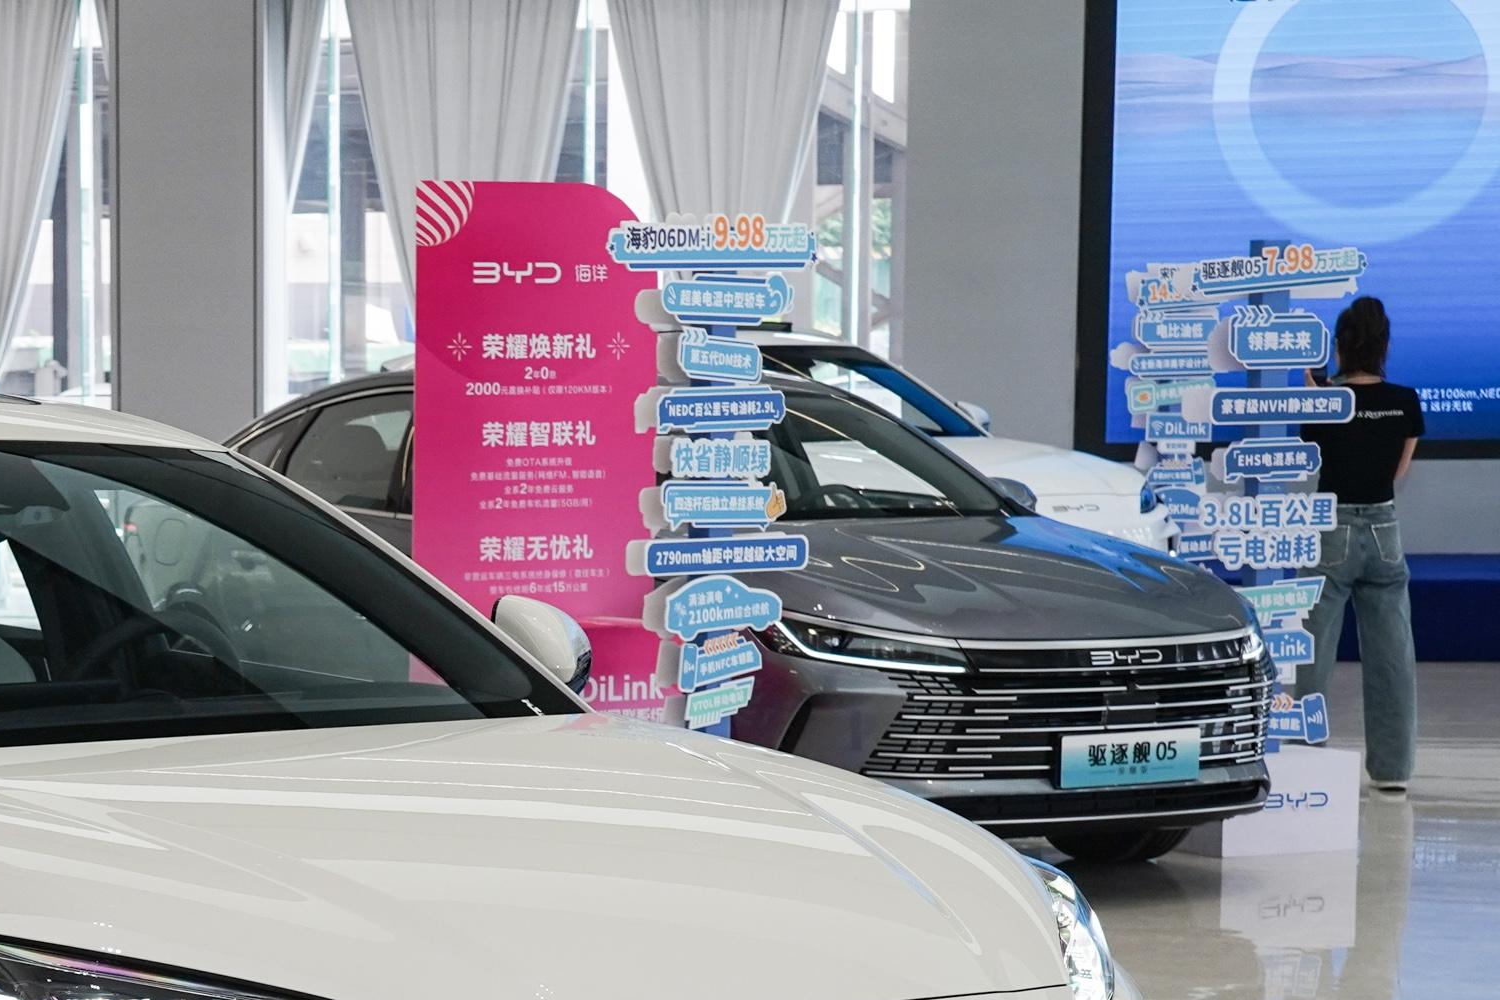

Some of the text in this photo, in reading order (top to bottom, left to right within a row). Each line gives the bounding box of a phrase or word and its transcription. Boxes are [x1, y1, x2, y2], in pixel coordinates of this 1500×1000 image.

[473, 262, 609, 284] BYD 海洋
[1202, 259, 1262, 280] 驱逐舰05
[482, 333, 597, 360] 荣耀焕新礼
[482, 420, 597, 447] 荣耀智联礼
[1164, 422, 1207, 437] DiLink
[1203, 498, 1334, 528] 3.8L百公里
[479, 534, 594, 563] 荣耀无忧礼
[1219, 535, 1318, 565] 亏电油耗
[1090, 649, 1163, 666] BYD
[1268, 637, 1308, 657] Link
[1088, 741, 1178, 766] 驱逐舰 05
[1265, 792, 1329, 809] BYD
